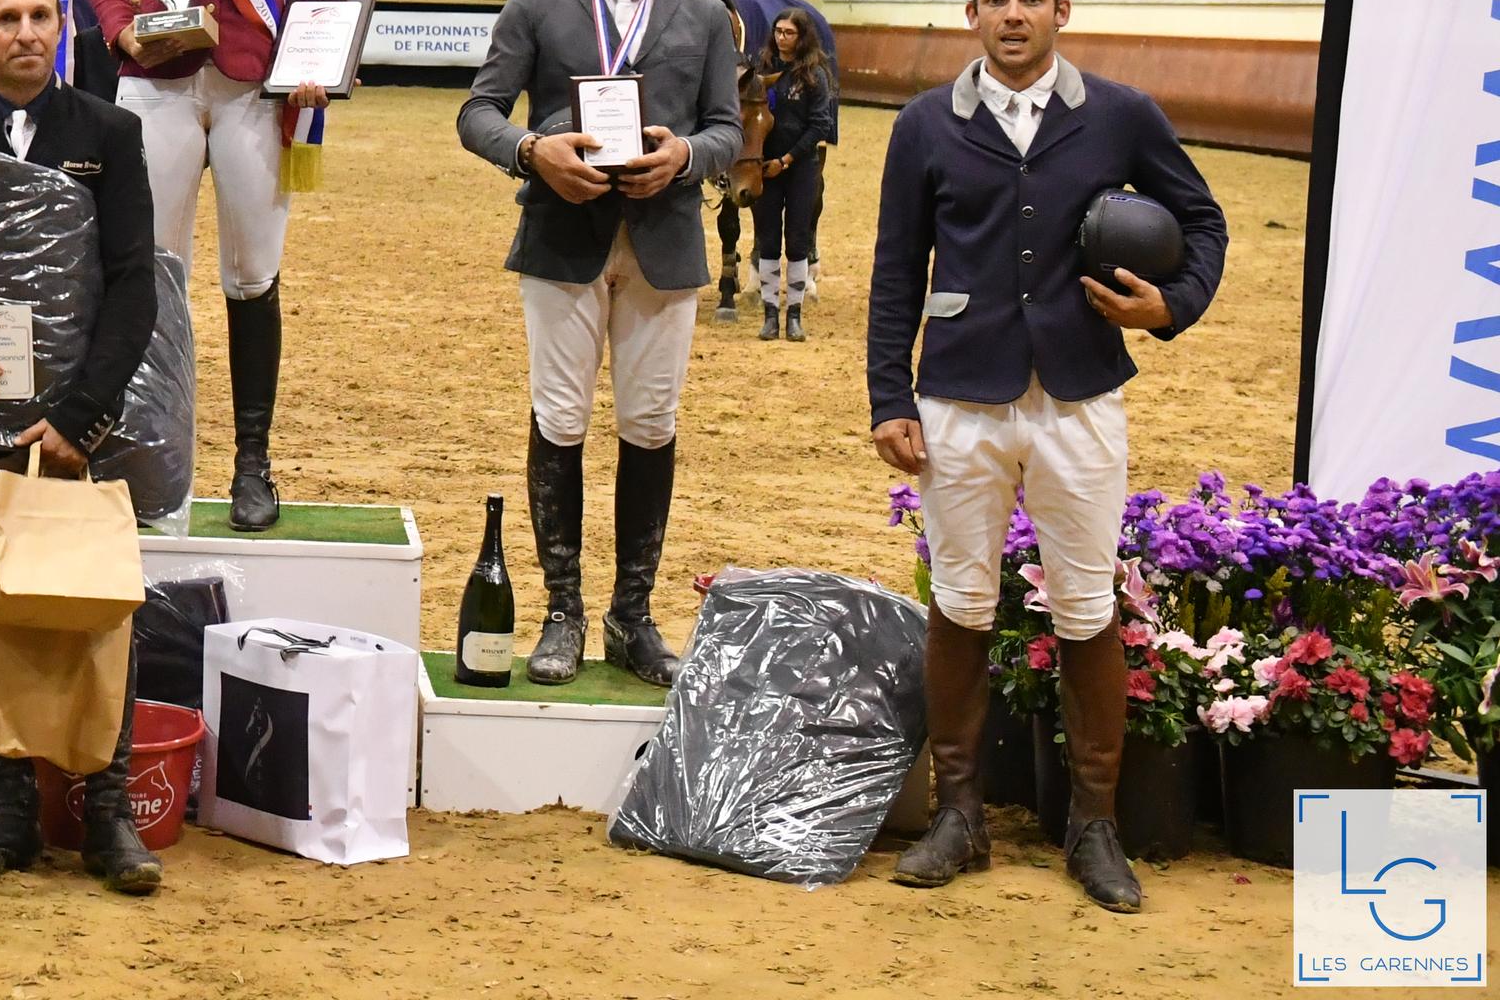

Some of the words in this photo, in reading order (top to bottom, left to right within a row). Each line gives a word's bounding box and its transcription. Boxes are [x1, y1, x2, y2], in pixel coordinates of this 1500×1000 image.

[376, 24, 489, 37] CHAMPIONNATS
[394, 41, 412, 51] DE
[416, 41, 470, 52] FRANCE
